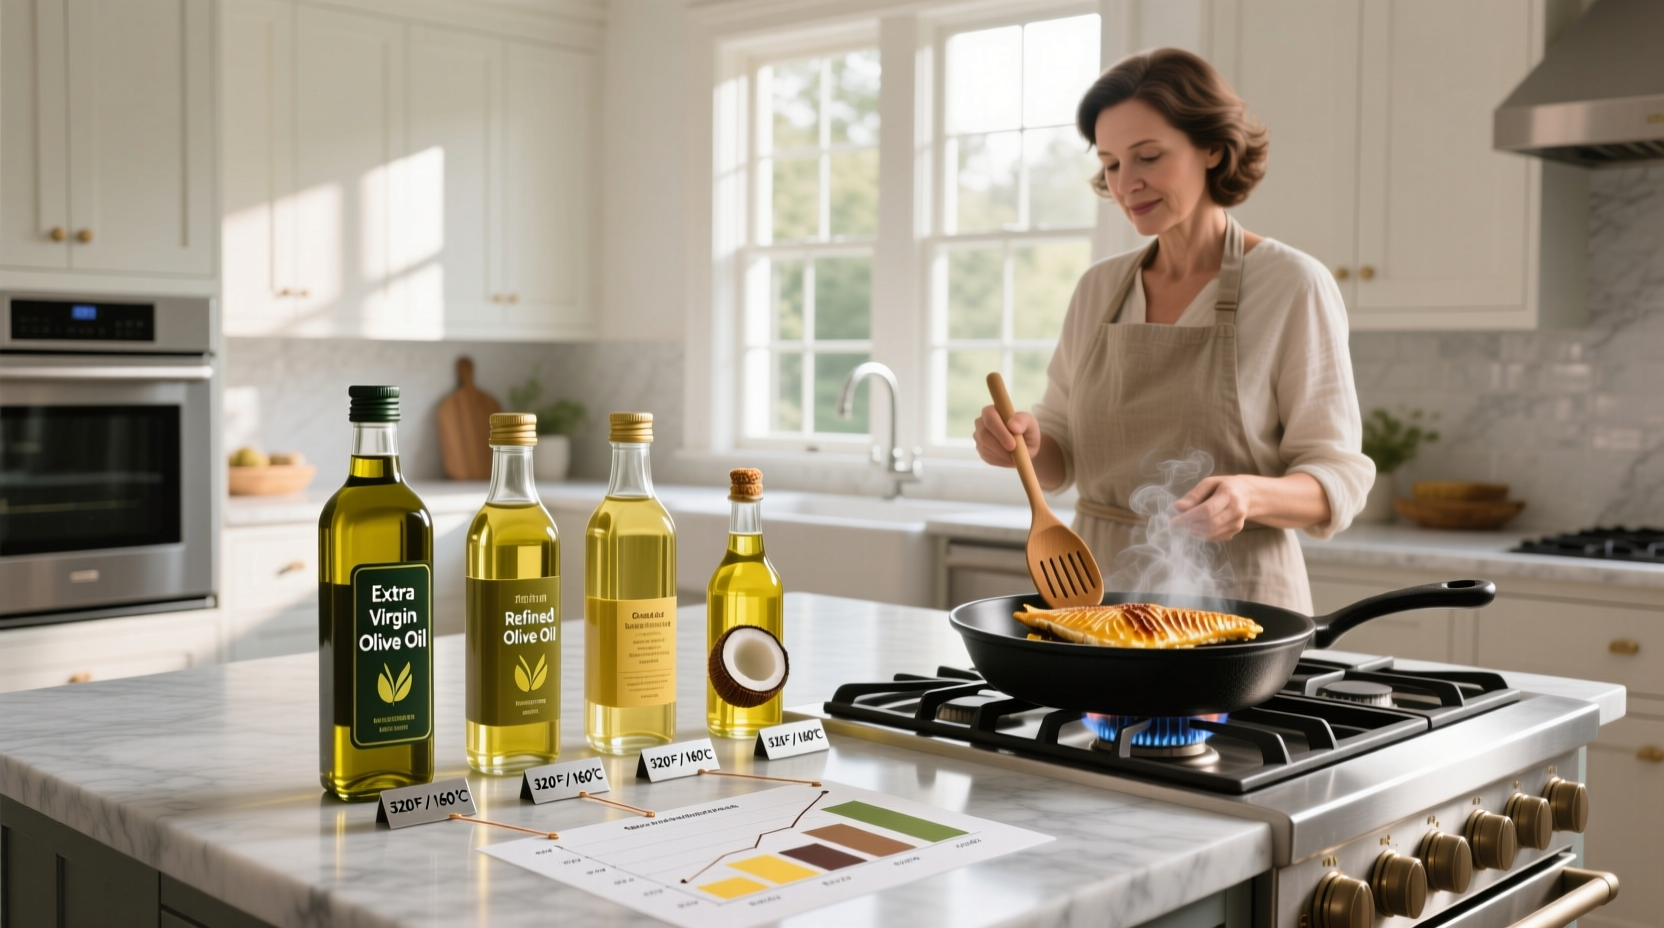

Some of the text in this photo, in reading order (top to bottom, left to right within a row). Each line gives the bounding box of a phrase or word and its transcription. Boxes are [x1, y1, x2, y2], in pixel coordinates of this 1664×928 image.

[372, 585, 415, 603] Extra
[369, 607, 418, 630] Virgin
[505, 606, 555, 626] Refined
[359, 628, 427, 652] Olive Oil
[503, 628, 538, 645] Olive
[533, 774, 565, 791] 320F
[389, 796, 423, 814] 320F
